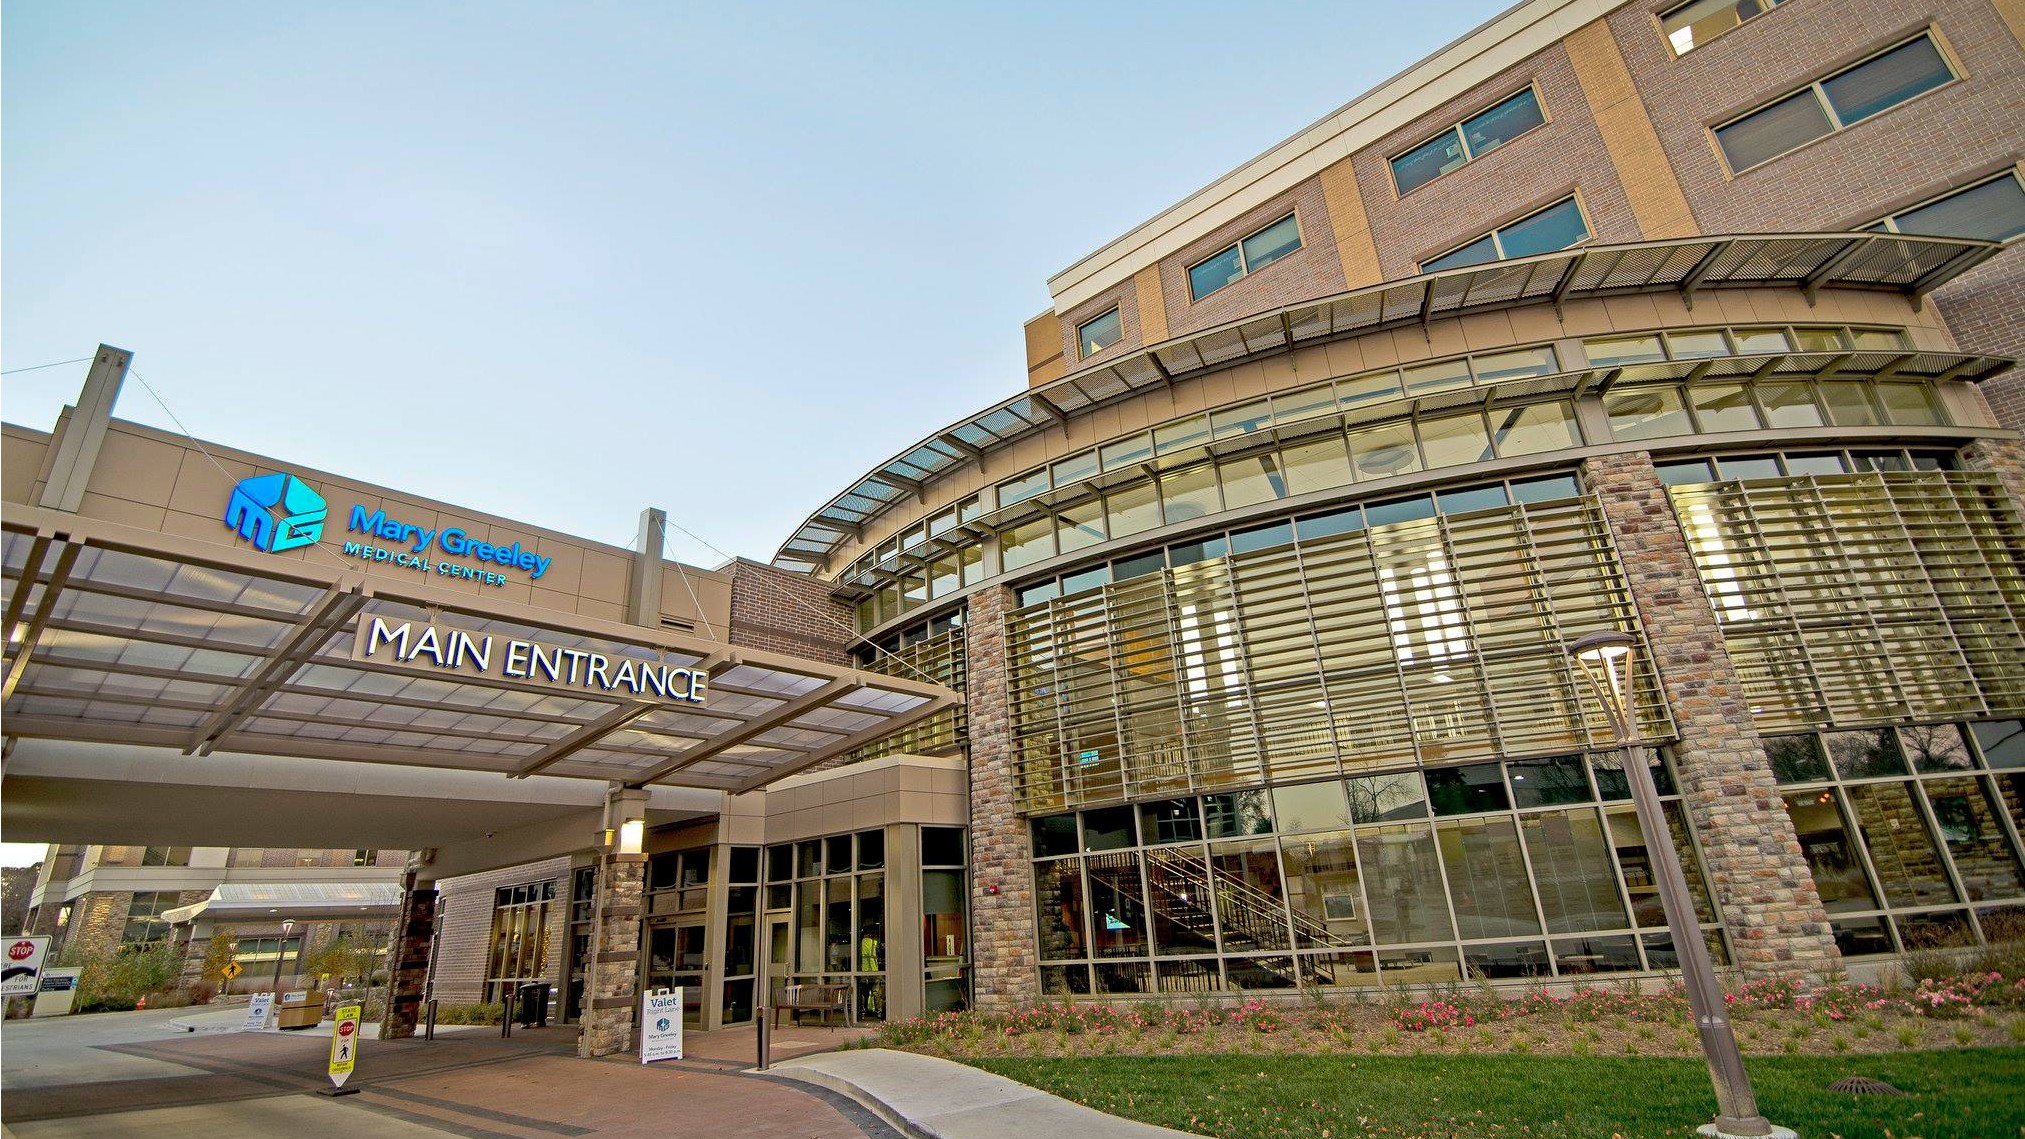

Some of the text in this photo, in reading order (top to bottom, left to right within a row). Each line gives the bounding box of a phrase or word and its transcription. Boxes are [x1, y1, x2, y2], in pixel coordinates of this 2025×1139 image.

[349, 504, 553, 579] Mary Greeley
[343, 541, 507, 587] MEDICAL CENTER
[366, 617, 706, 702] MAIN ENTRANCE
[9, 946, 34, 956] STOP
[15, 975, 29, 983] FOR
[651, 998, 677, 1007] Valet
